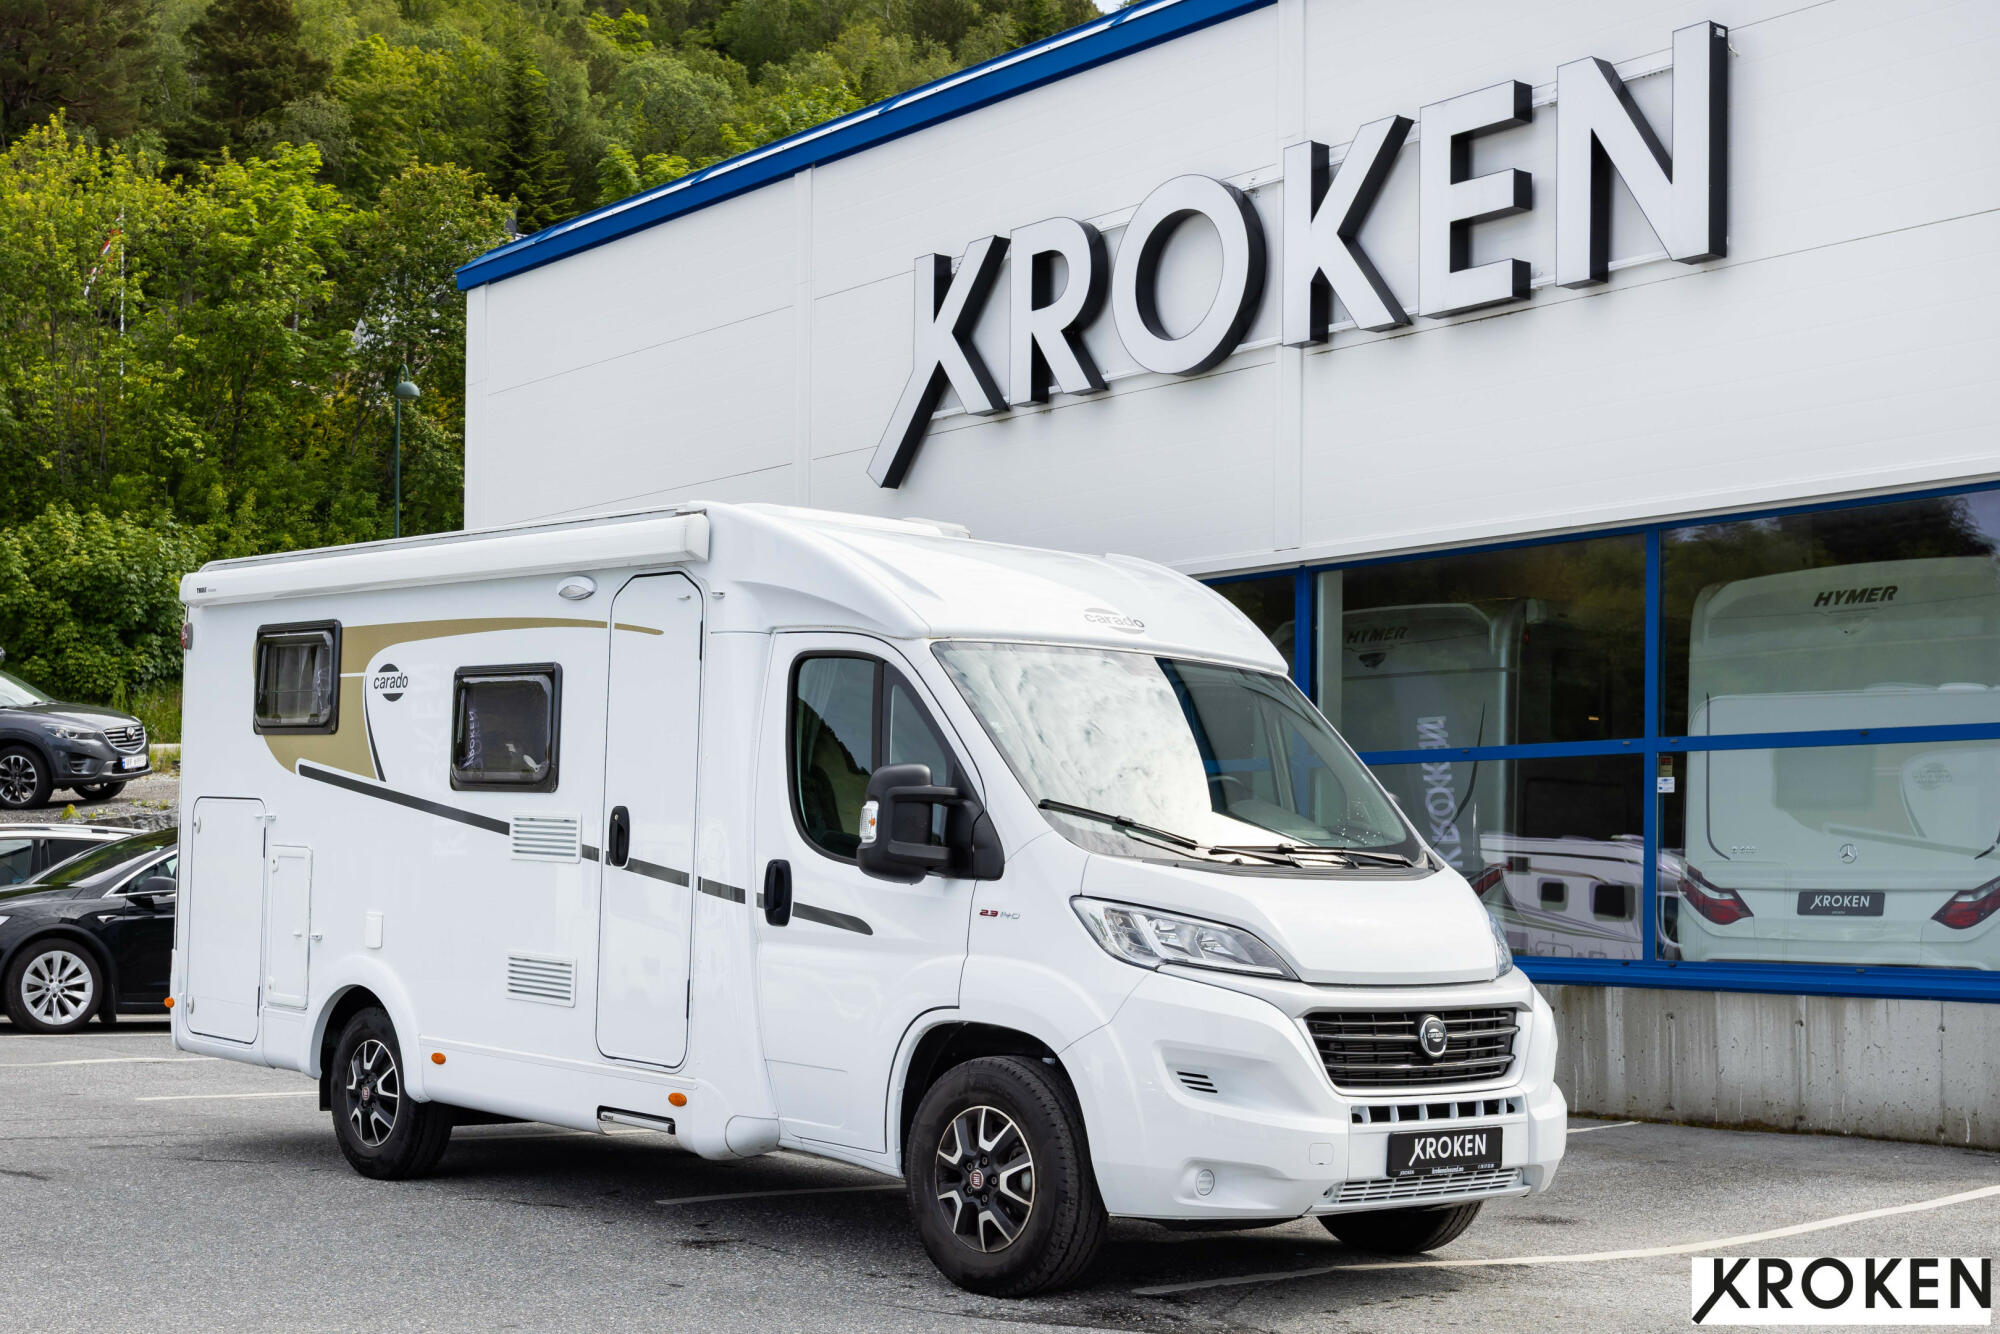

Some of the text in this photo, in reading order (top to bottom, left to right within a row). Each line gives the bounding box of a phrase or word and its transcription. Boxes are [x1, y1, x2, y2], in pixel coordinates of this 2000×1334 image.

[866, 20, 1729, 489] KROKEN
[1813, 585, 1898, 607] HYMER
[1083, 614, 1145, 628] carado
[1346, 626, 1408, 644] HYMER
[373, 672, 409, 689] carado
[1809, 895, 1871, 910] KROKEN
[1408, 1134, 1487, 1167] KROKEN
